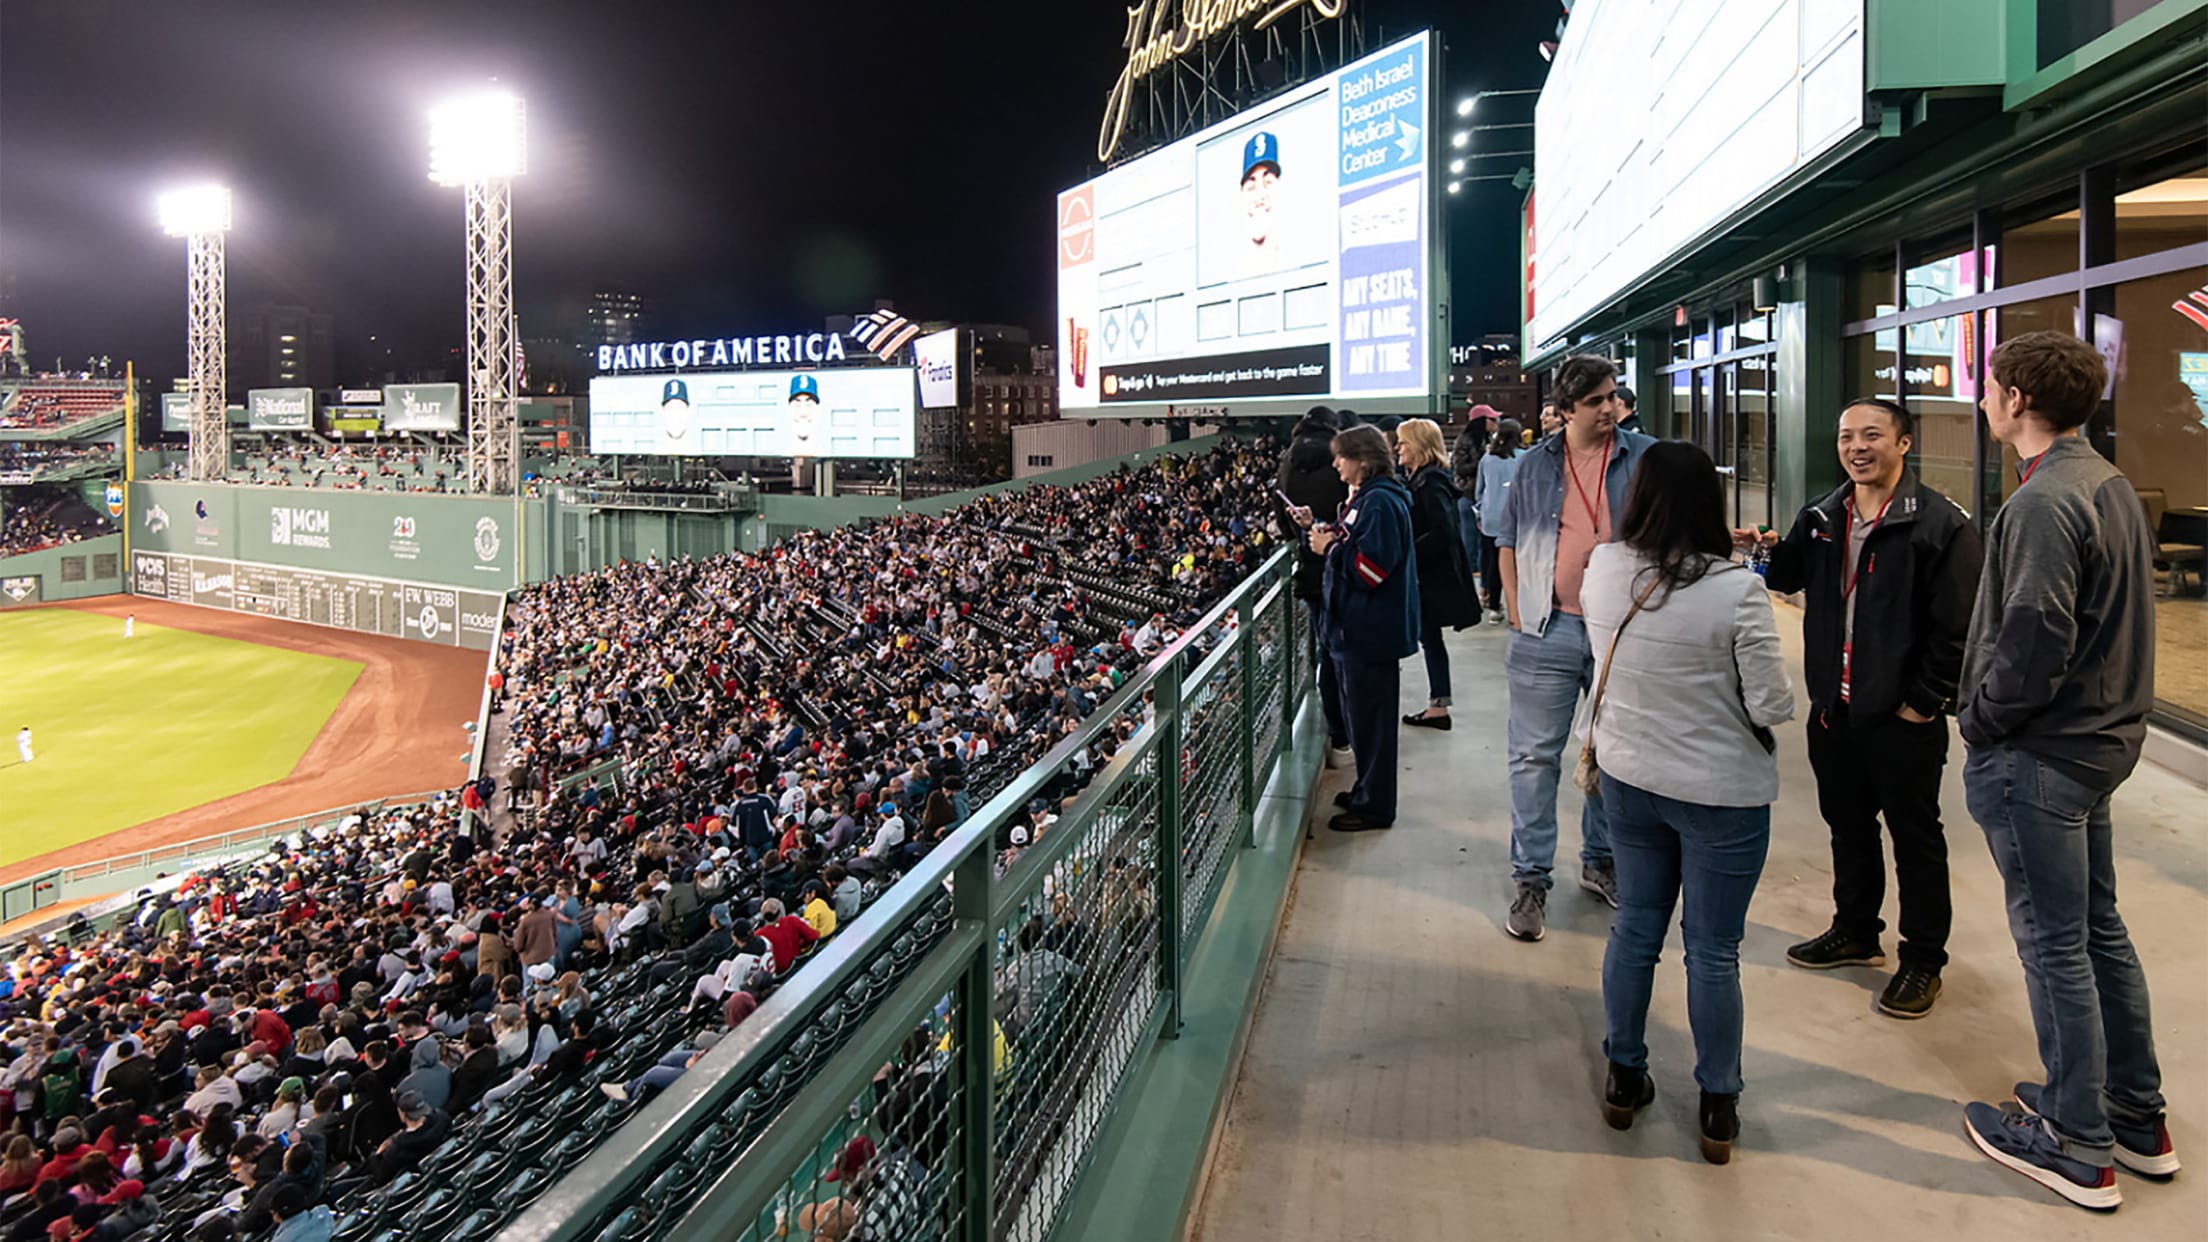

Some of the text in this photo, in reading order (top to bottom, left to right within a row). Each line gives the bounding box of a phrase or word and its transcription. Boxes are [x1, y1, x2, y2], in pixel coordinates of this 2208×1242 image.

[1098, 0, 1174, 162] John
[1342, 53, 1414, 103] Beth Israel
[1342, 85, 1417, 128] Deaconess
[1342, 111, 1396, 152] Medical
[1342, 146, 1389, 175] Center
[1369, 267, 1417, 304] SEATS,
[598, 332, 846, 370] BANK OF AMERICA
[1276, 367, 1298, 381] game
[292, 508, 330, 533] MGM
